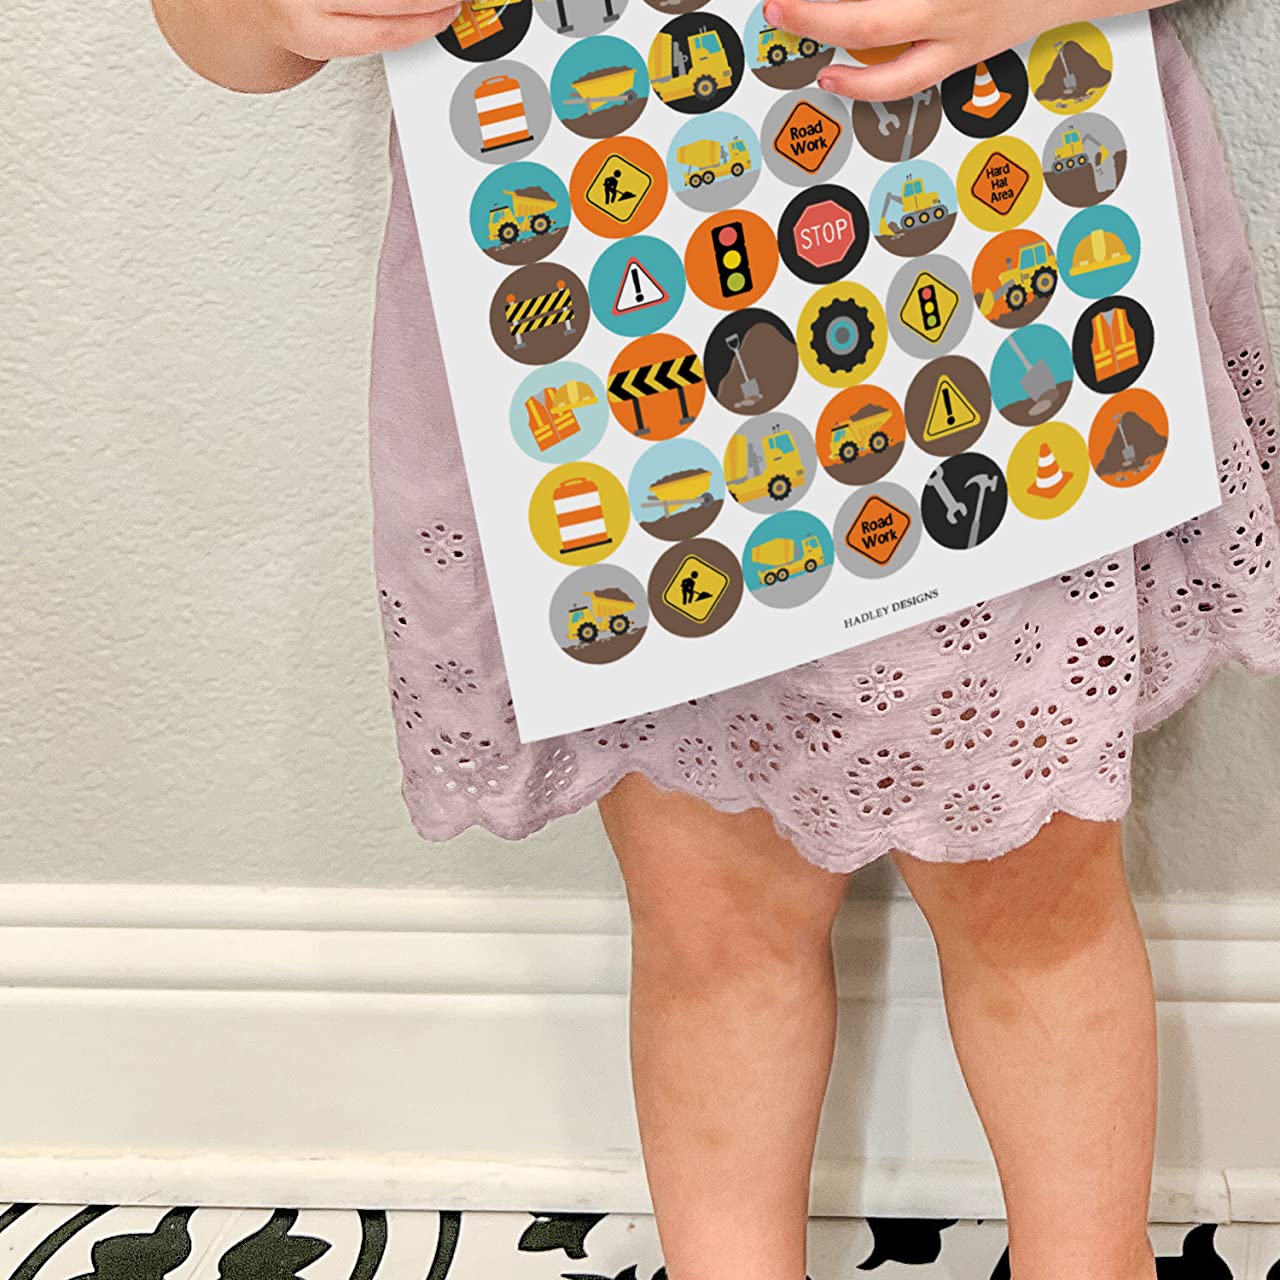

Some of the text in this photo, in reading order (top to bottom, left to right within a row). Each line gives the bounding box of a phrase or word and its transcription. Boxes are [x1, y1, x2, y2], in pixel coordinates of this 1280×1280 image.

[790, 120, 823, 141] Road
[790, 136, 828, 156] Work
[985, 163, 1010, 179] Hard
[991, 188, 1014, 203] Area
[800, 218, 848, 250] STOP
[861, 513, 893, 534] Road
[861, 529, 898, 549] Work
[843, 588, 939, 628] HADLEY DESIGNS
